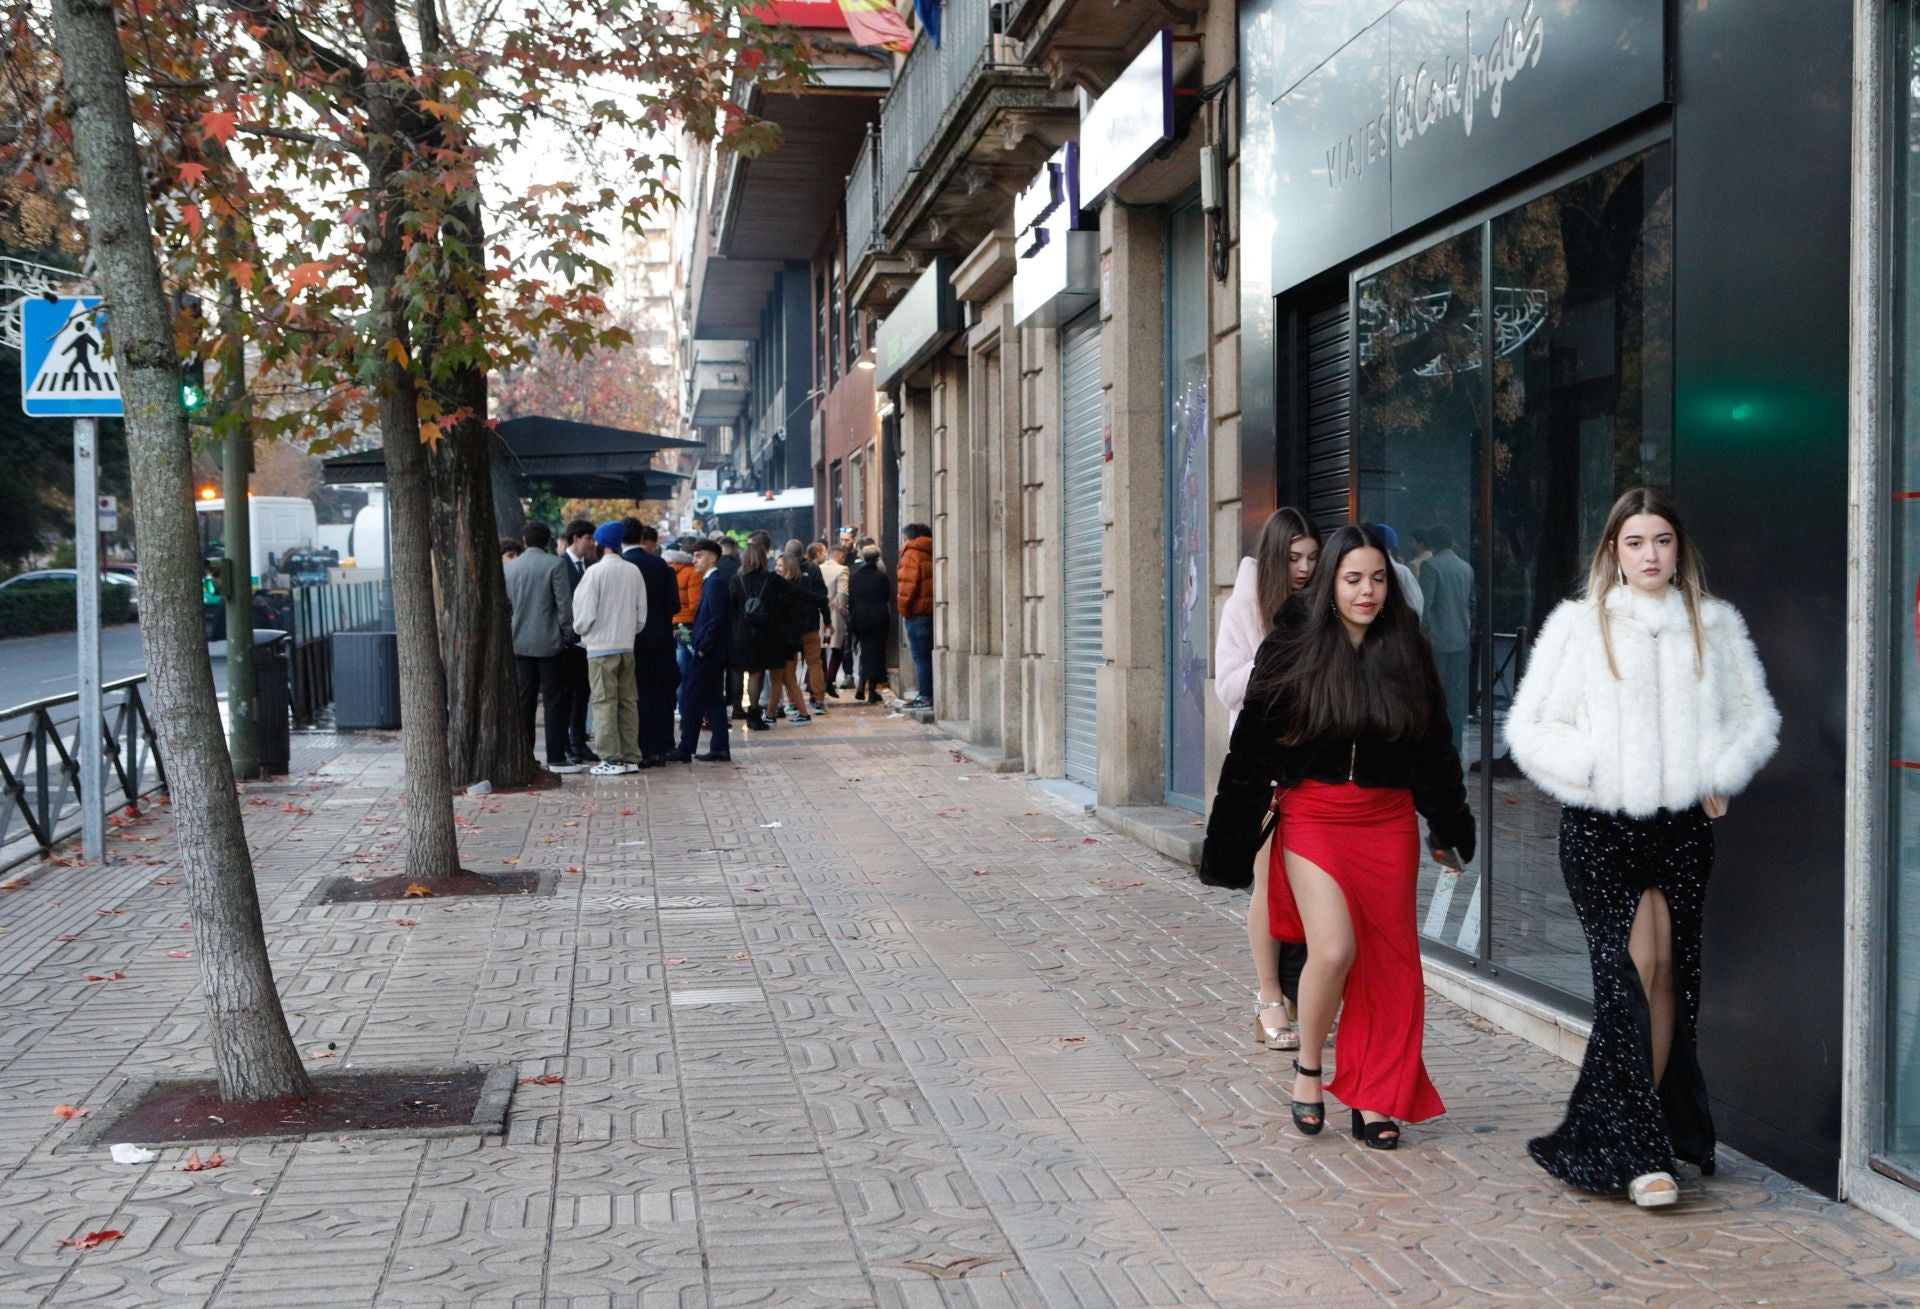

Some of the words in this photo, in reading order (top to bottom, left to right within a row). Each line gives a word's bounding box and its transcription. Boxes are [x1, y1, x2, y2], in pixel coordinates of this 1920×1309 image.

[1326, 112, 1390, 188] VIAJES
[1394, 74, 1413, 148] El
[1414, 55, 1461, 136] Corte
[1464, 0, 1544, 137] Inglés
